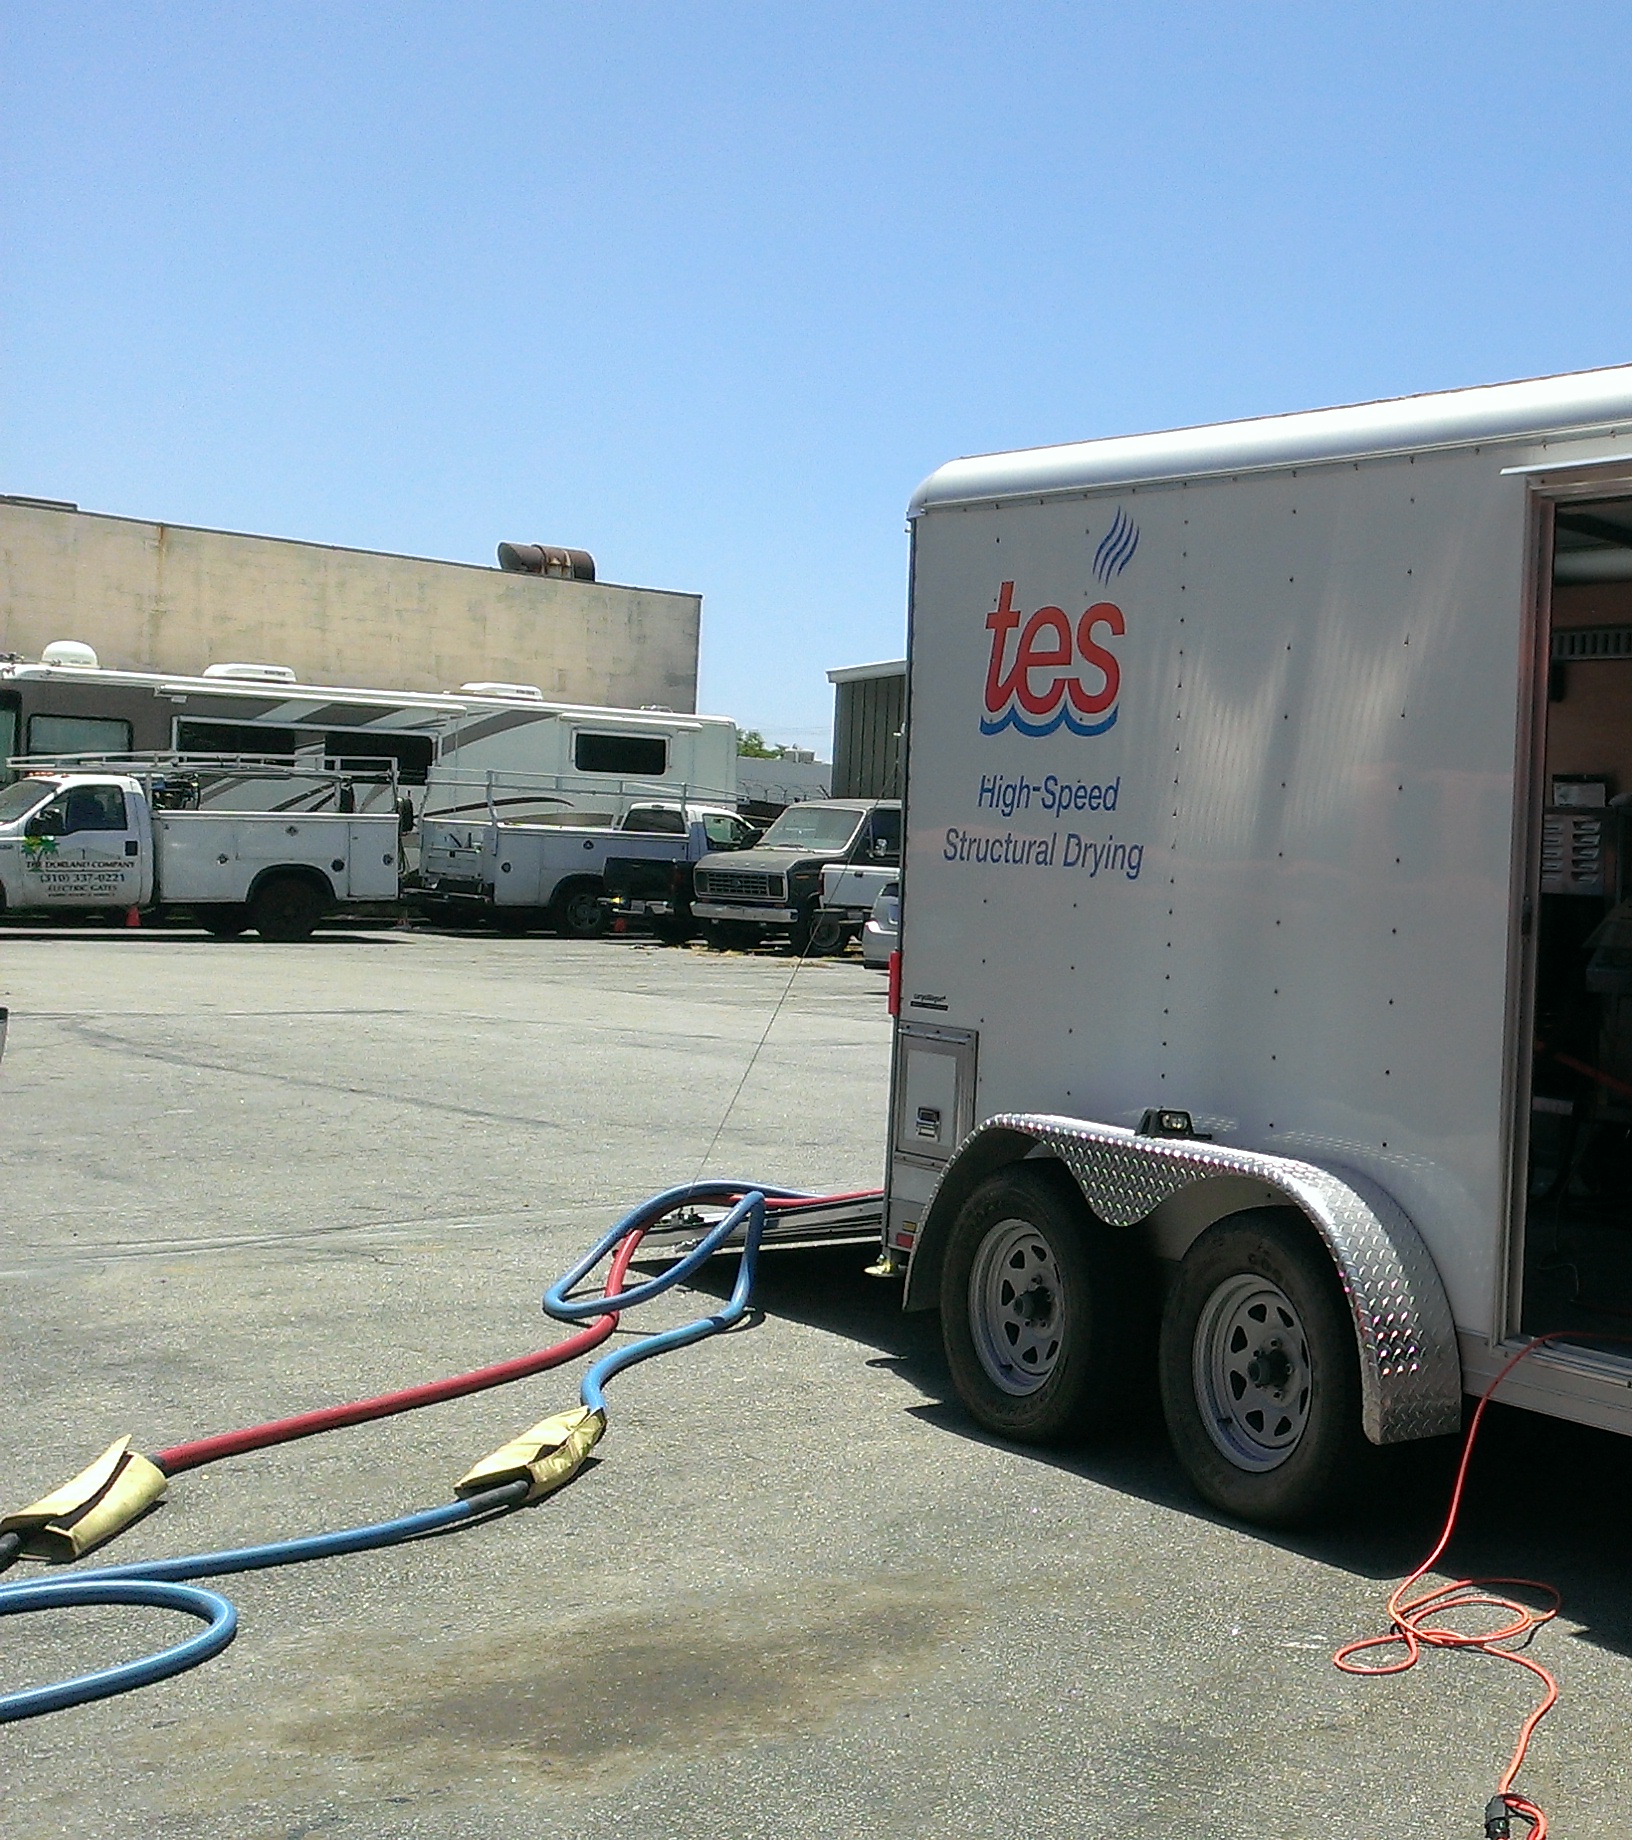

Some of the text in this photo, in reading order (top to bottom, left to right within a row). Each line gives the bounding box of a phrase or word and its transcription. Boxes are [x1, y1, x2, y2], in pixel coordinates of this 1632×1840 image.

[984, 580, 1126, 715] tes
[977, 774, 1121, 818] High-Speed
[91, 861, 135, 869] COMPANY
[943, 828, 1145, 880] Structural Drying
